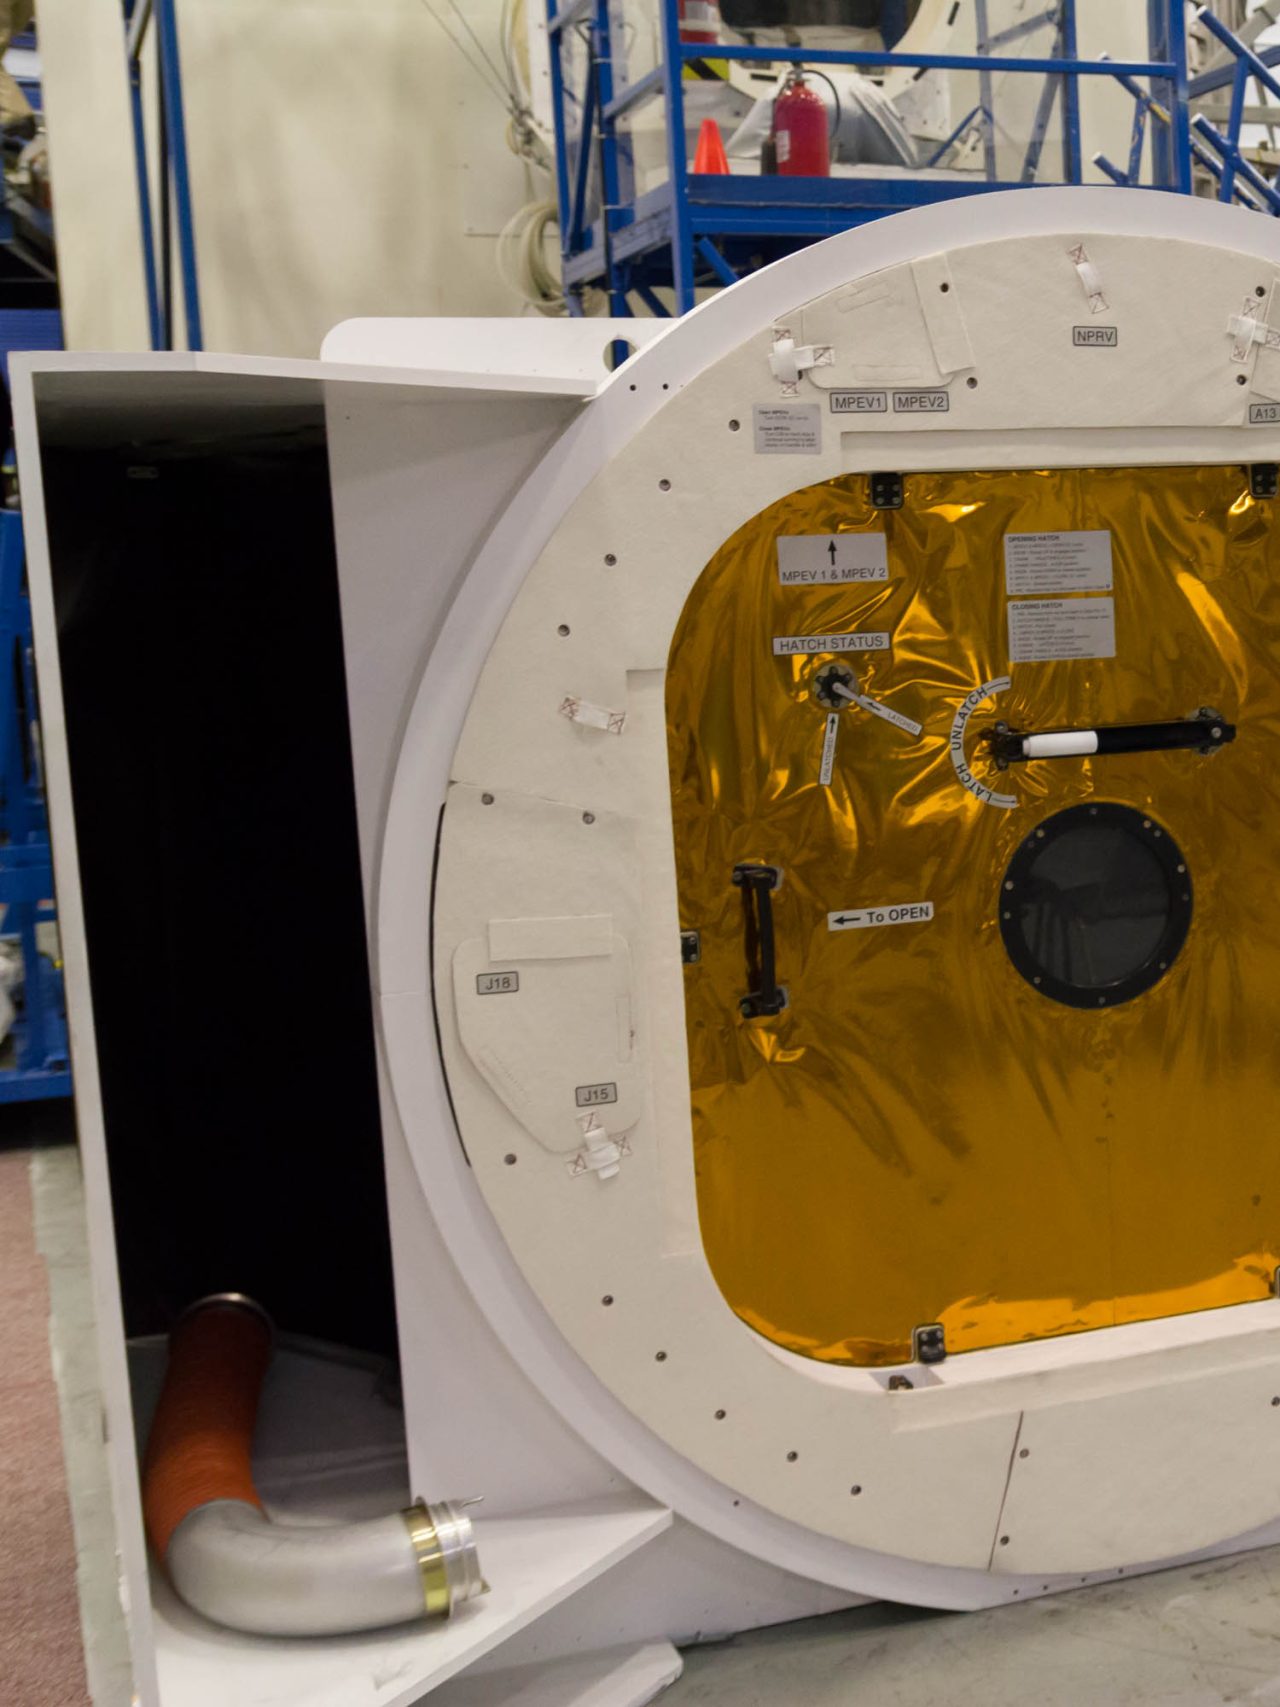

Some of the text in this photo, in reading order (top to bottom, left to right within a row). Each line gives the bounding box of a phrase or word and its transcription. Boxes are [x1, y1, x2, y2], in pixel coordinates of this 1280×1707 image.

[1077, 330, 1114, 342] NPRV
[835, 396, 881, 409] MPEV1
[898, 395, 945, 408] MPEV2
[1254, 408, 1277, 420] A13
[782, 567, 886, 581] MPEV 1 & MPEV 2
[780, 635, 883, 651] HATCH STATUS
[952, 686, 988, 751] UNLATCH
[956, 763, 992, 802] LATCH
[867, 906, 930, 923] To OPEN
[485, 977, 511, 990] J18
[584, 1088, 609, 1102] J15
